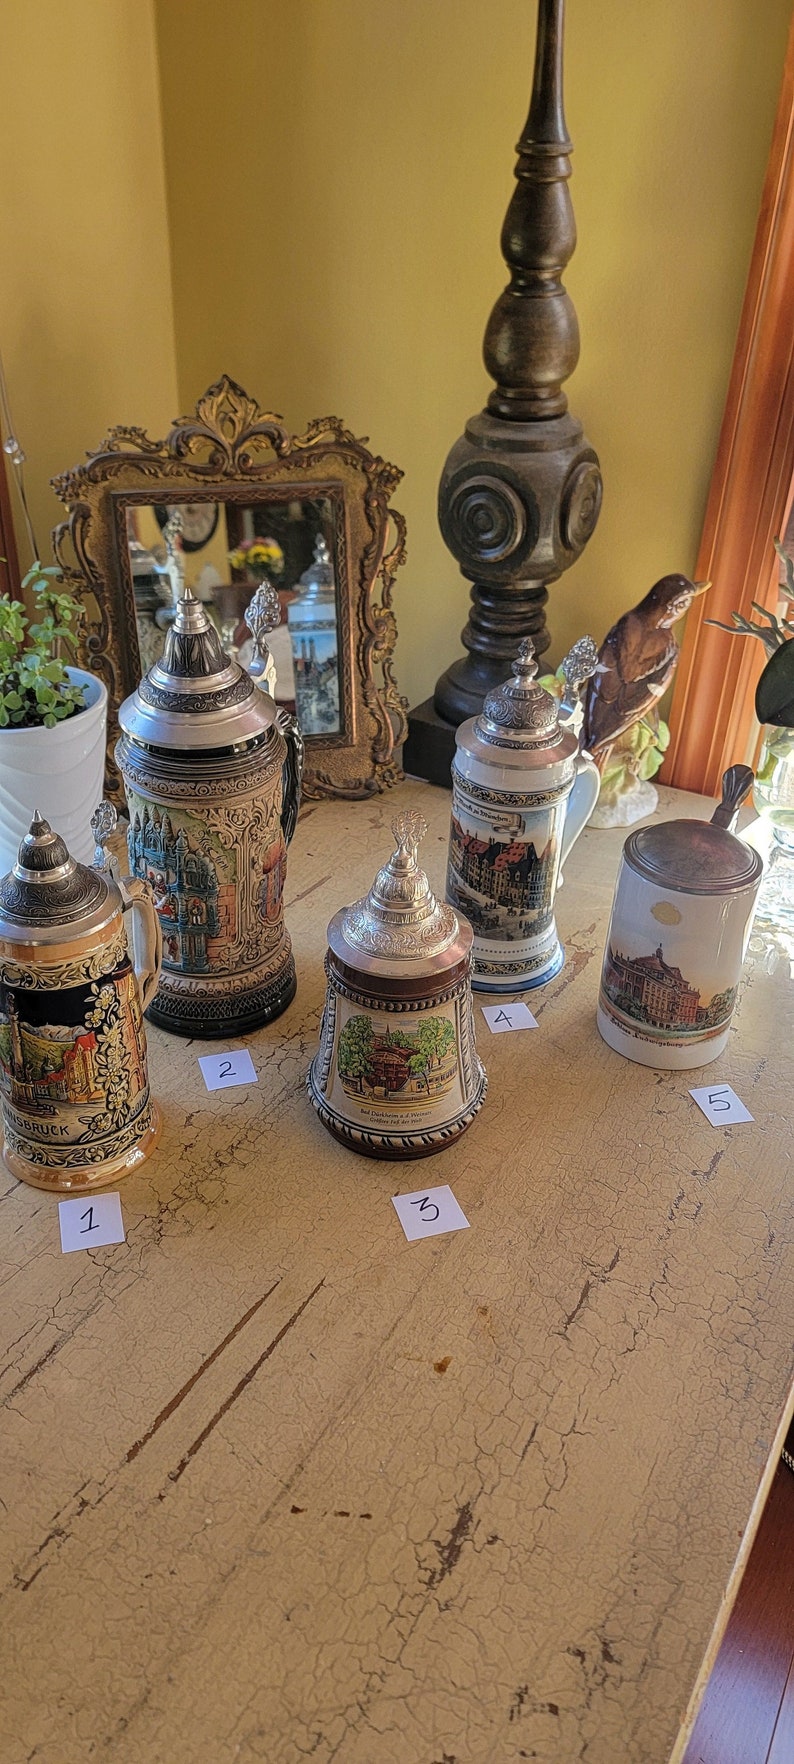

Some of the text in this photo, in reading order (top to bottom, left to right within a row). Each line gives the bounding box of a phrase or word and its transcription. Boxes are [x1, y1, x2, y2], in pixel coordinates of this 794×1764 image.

[494, 1009, 512, 1027] 4
[219, 1061, 237, 1078] 2
[708, 1090, 731, 1111] 5
[360, 1108, 371, 1116] Bad
[371, 1110, 399, 1119] Dürkheim
[410, 1197, 440, 1222] 3
[80, 1206, 100, 1234] 1
